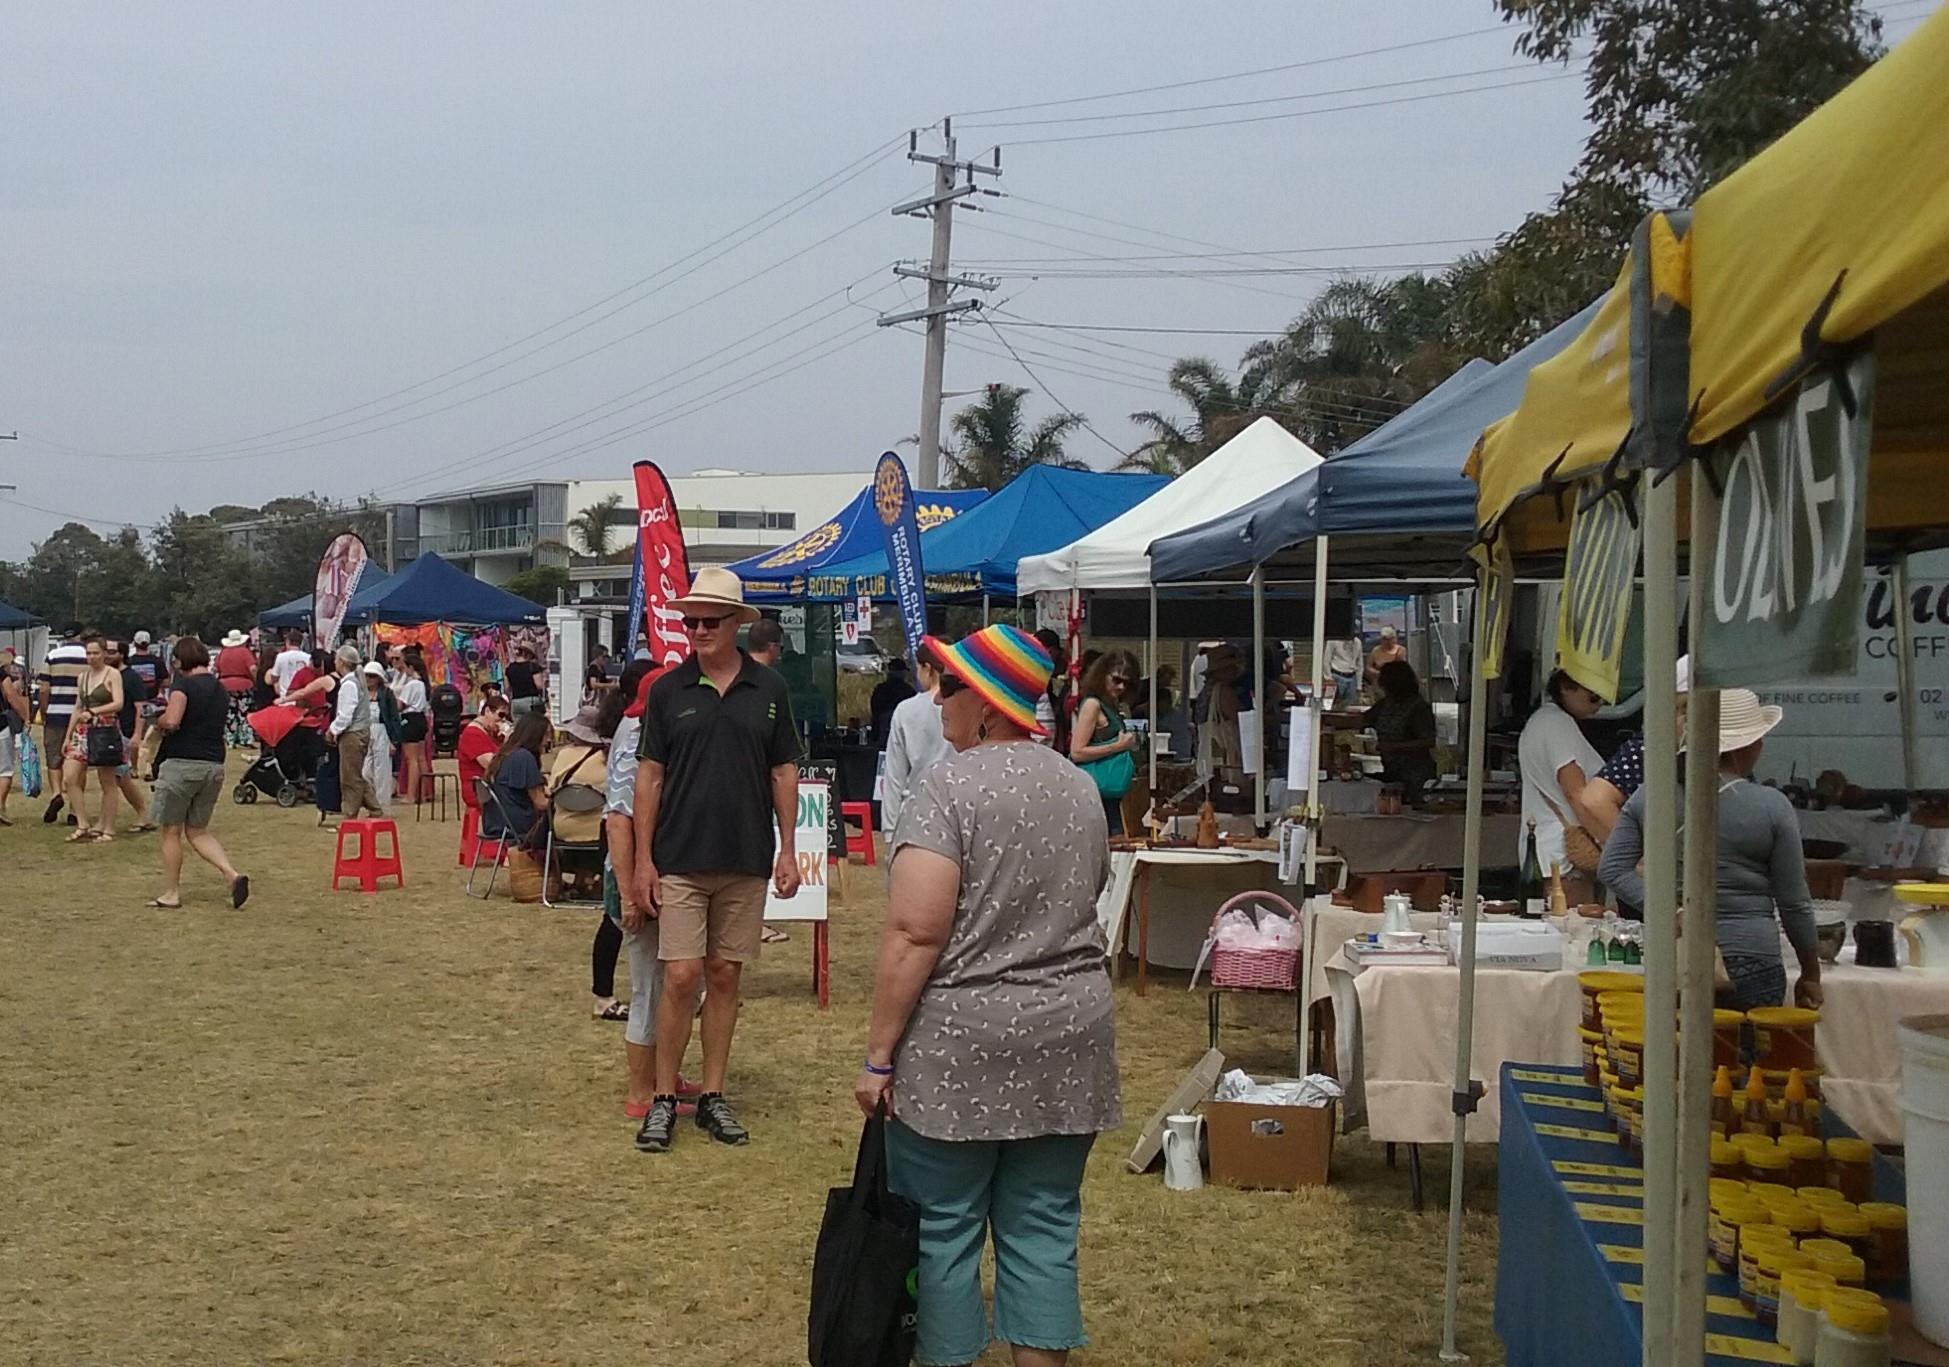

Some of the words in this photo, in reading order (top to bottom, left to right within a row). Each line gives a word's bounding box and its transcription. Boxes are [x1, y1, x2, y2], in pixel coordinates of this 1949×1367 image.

[807, 576, 849, 597] ROTARY
[856, 575, 886, 596] CLUB
[897, 526, 915, 587] ROTARY
[911, 592, 923, 635] CLUB
[1865, 635, 1949, 659] COFF
[1773, 693, 1800, 704] FINE
[1810, 693, 1861, 705] COFFEE
[1919, 689, 1943, 704] 02
